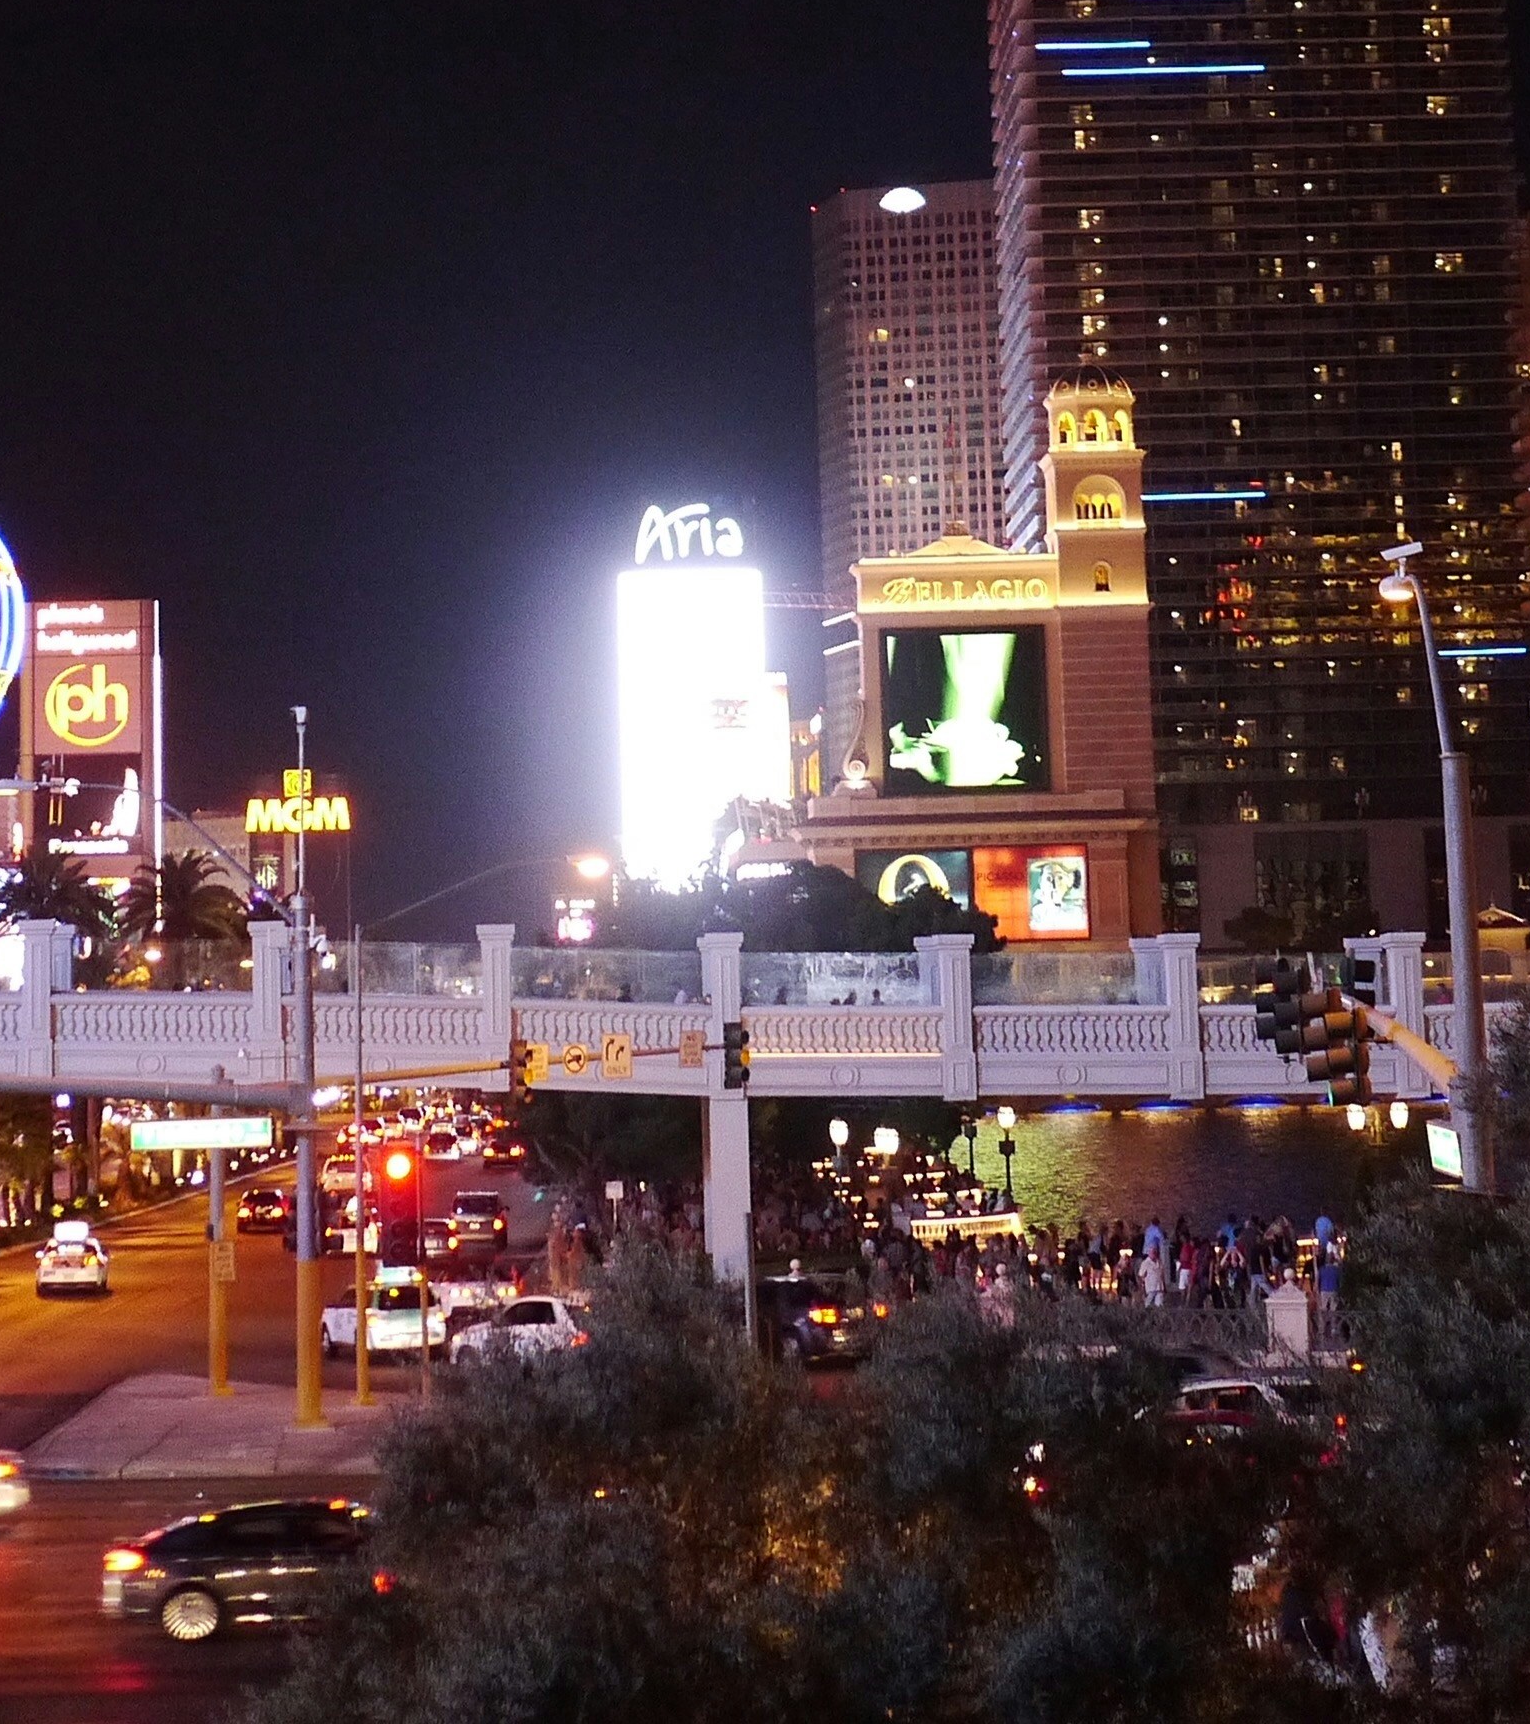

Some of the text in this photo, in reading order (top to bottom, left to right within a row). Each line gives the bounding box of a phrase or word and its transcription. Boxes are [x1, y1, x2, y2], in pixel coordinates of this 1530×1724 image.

[634, 503, 744, 565] Aria
[872, 577, 1048, 604] BELLAGIO
[54, 663, 129, 739] ph
[245, 796, 351, 834] MGM
[606, 1066, 628, 1074] ONLY
